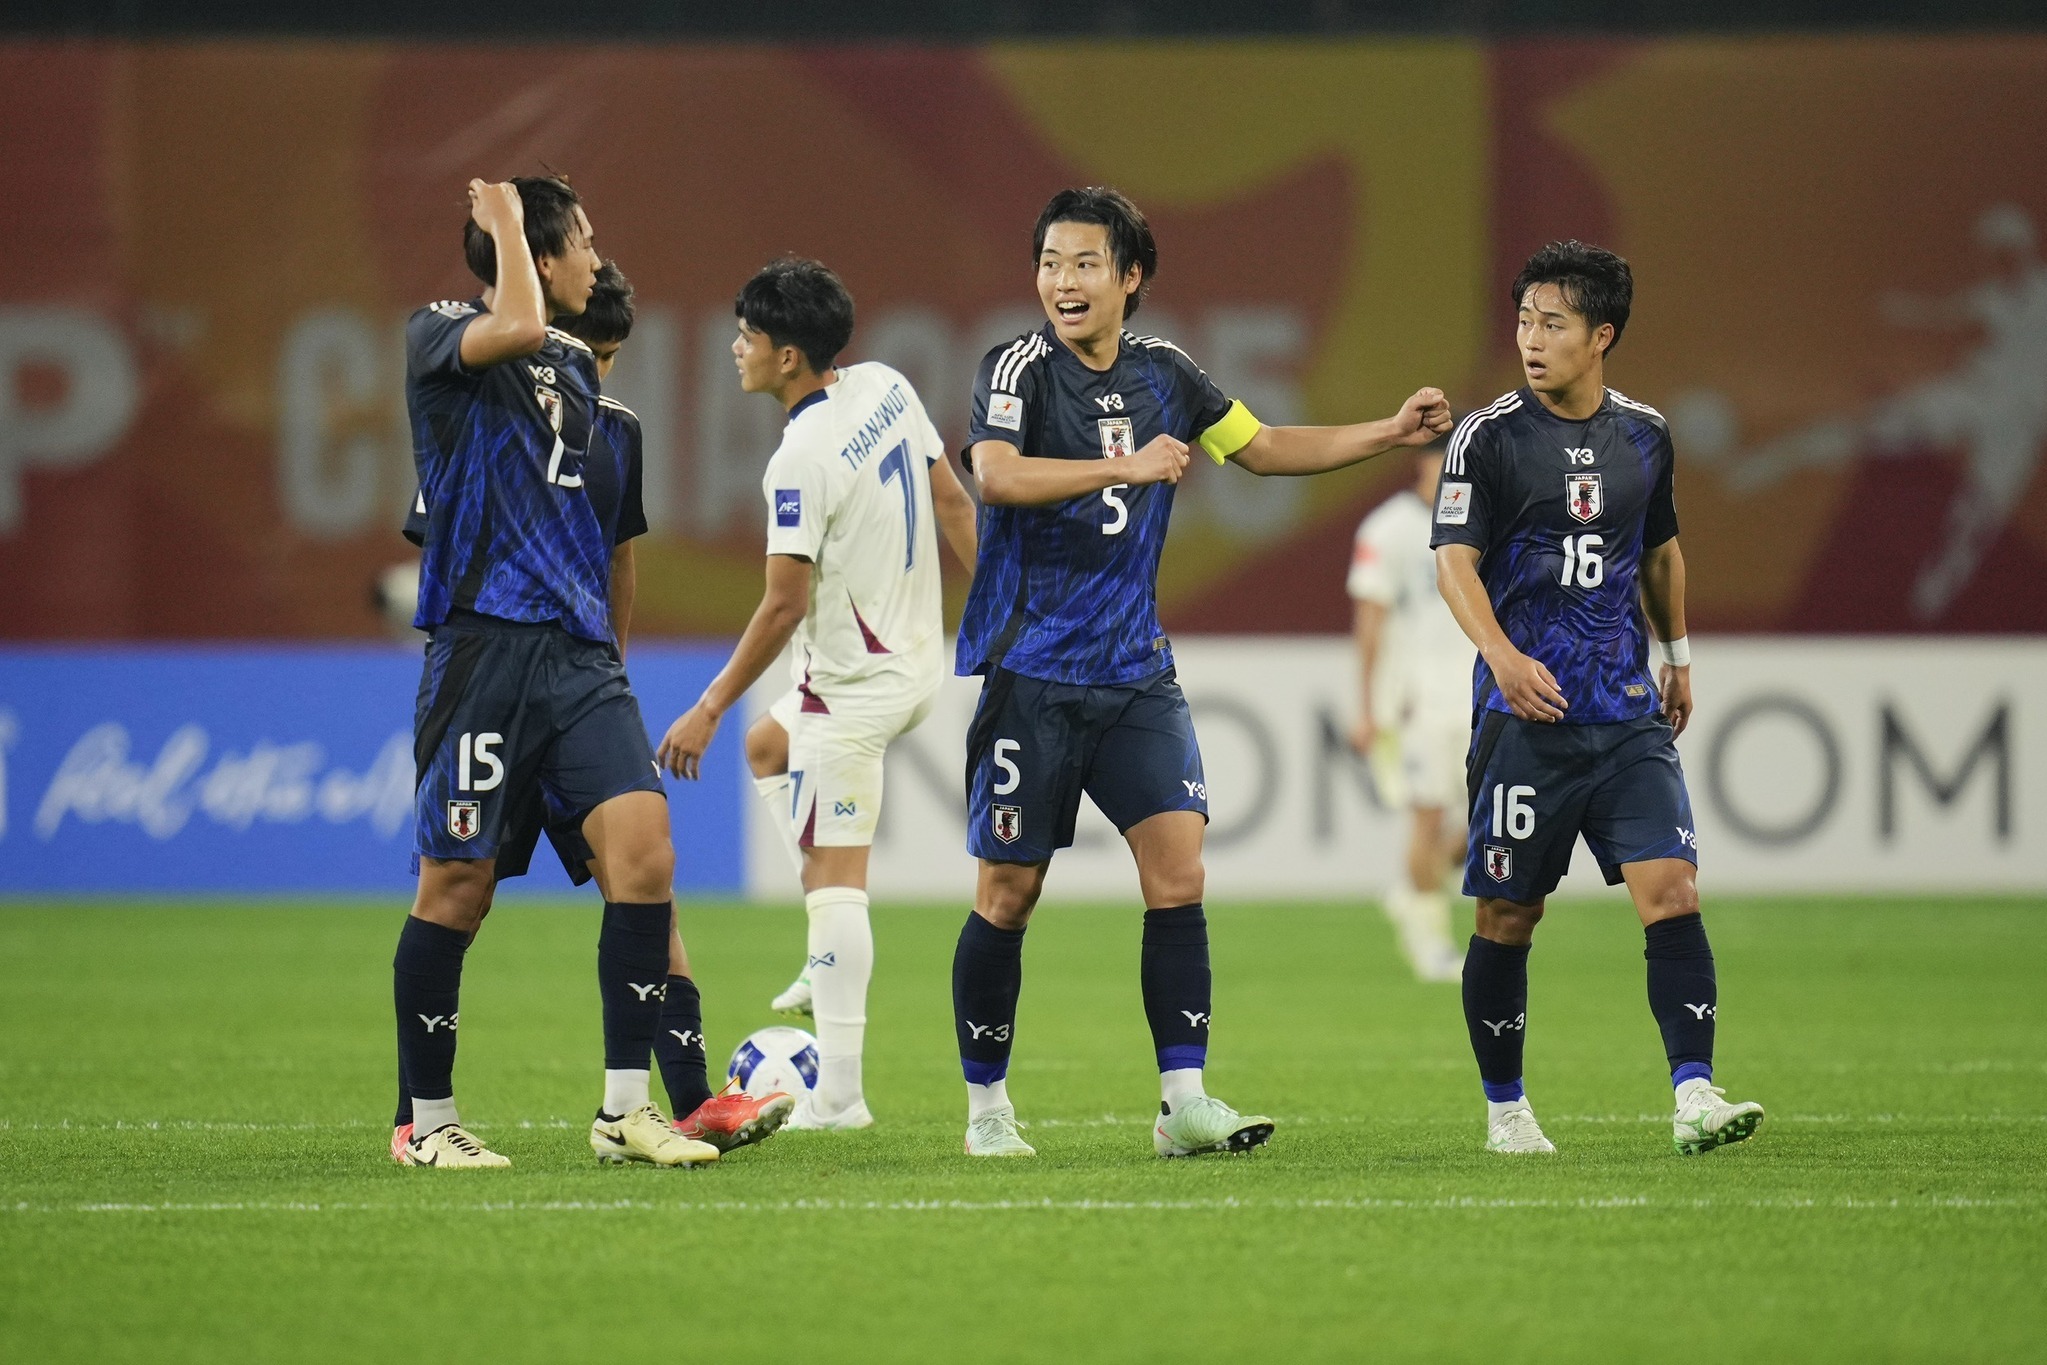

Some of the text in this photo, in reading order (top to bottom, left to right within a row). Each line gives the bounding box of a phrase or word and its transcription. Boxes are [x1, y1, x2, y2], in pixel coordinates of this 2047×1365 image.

[528, 365, 556, 385] Y-3
[841, 384, 909, 471] THANAWUT
[1095, 393, 1124, 413] Y-3
[1564, 448, 1595, 465] Y-3
[778, 502, 799, 512] AFC
[879, 438, 917, 575] 7
[1102, 483, 1128, 535] 5
[1561, 534, 1604, 589] 16
[459, 732, 504, 791] 15
[994, 738, 1021, 795] 5
[790, 770, 804, 819] 7
[1182, 780, 1206, 801] Y-3
[1493, 783, 1536, 840] 16
[966, 1020, 1010, 1042] Y-3
[1482, 1012, 1525, 1036] Y-3
